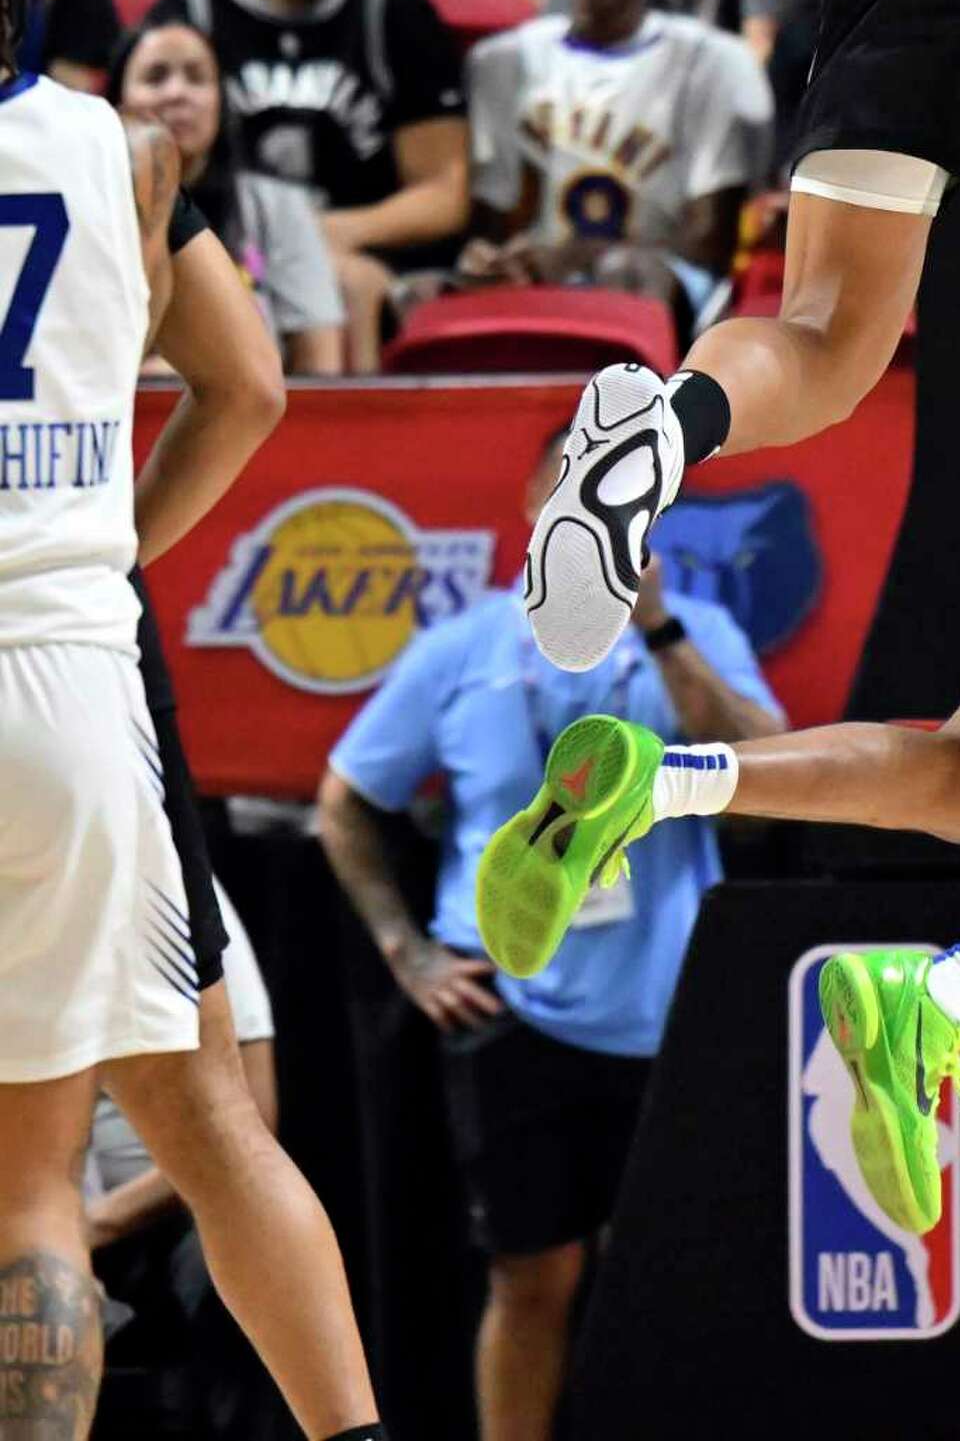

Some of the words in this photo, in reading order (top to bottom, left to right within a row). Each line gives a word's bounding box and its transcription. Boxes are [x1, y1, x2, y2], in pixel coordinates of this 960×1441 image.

[217, 543, 472, 631] LAKERS
[818, 1251, 898, 1312] NBA
[0, 1321, 75, 1364] ORLD
